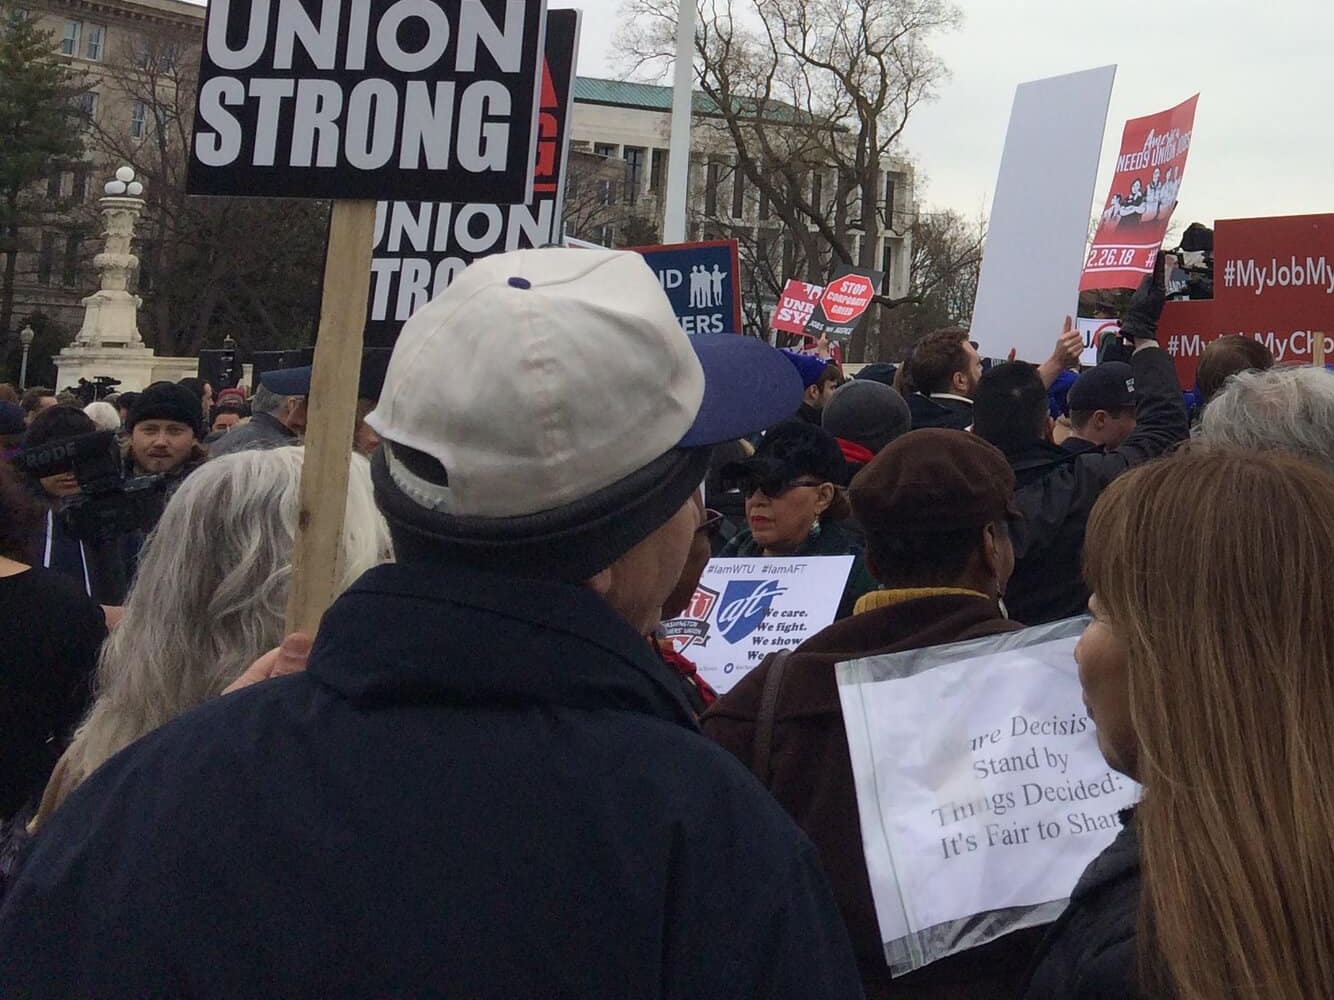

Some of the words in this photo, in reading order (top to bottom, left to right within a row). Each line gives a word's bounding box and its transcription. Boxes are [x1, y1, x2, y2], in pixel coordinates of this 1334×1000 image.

[195, 75, 512, 172] STRONG
[1116, 150, 1151, 172] NEEDS
[1087, 248, 1135, 267] 2.26.18
[840, 281, 867, 295] STOP
[707, 563, 755, 575] #IamWTU
[761, 563, 808, 574] #IamAFT
[781, 608, 808, 618] care.
[757, 623, 774, 632] We
[776, 622, 808, 633] fight.
[752, 636, 769, 646] We
[771, 636, 801, 646] show
[747, 651, 765, 660] We
[1010, 712, 1088, 737] Decisis
[972, 747, 1040, 780] Stand
[1045, 747, 1069, 774] by
[1022, 772, 1123, 807] Decided:
[940, 831, 978, 860] It's
[985, 823, 1031, 848] Fair
[1039, 819, 1061, 840] to
